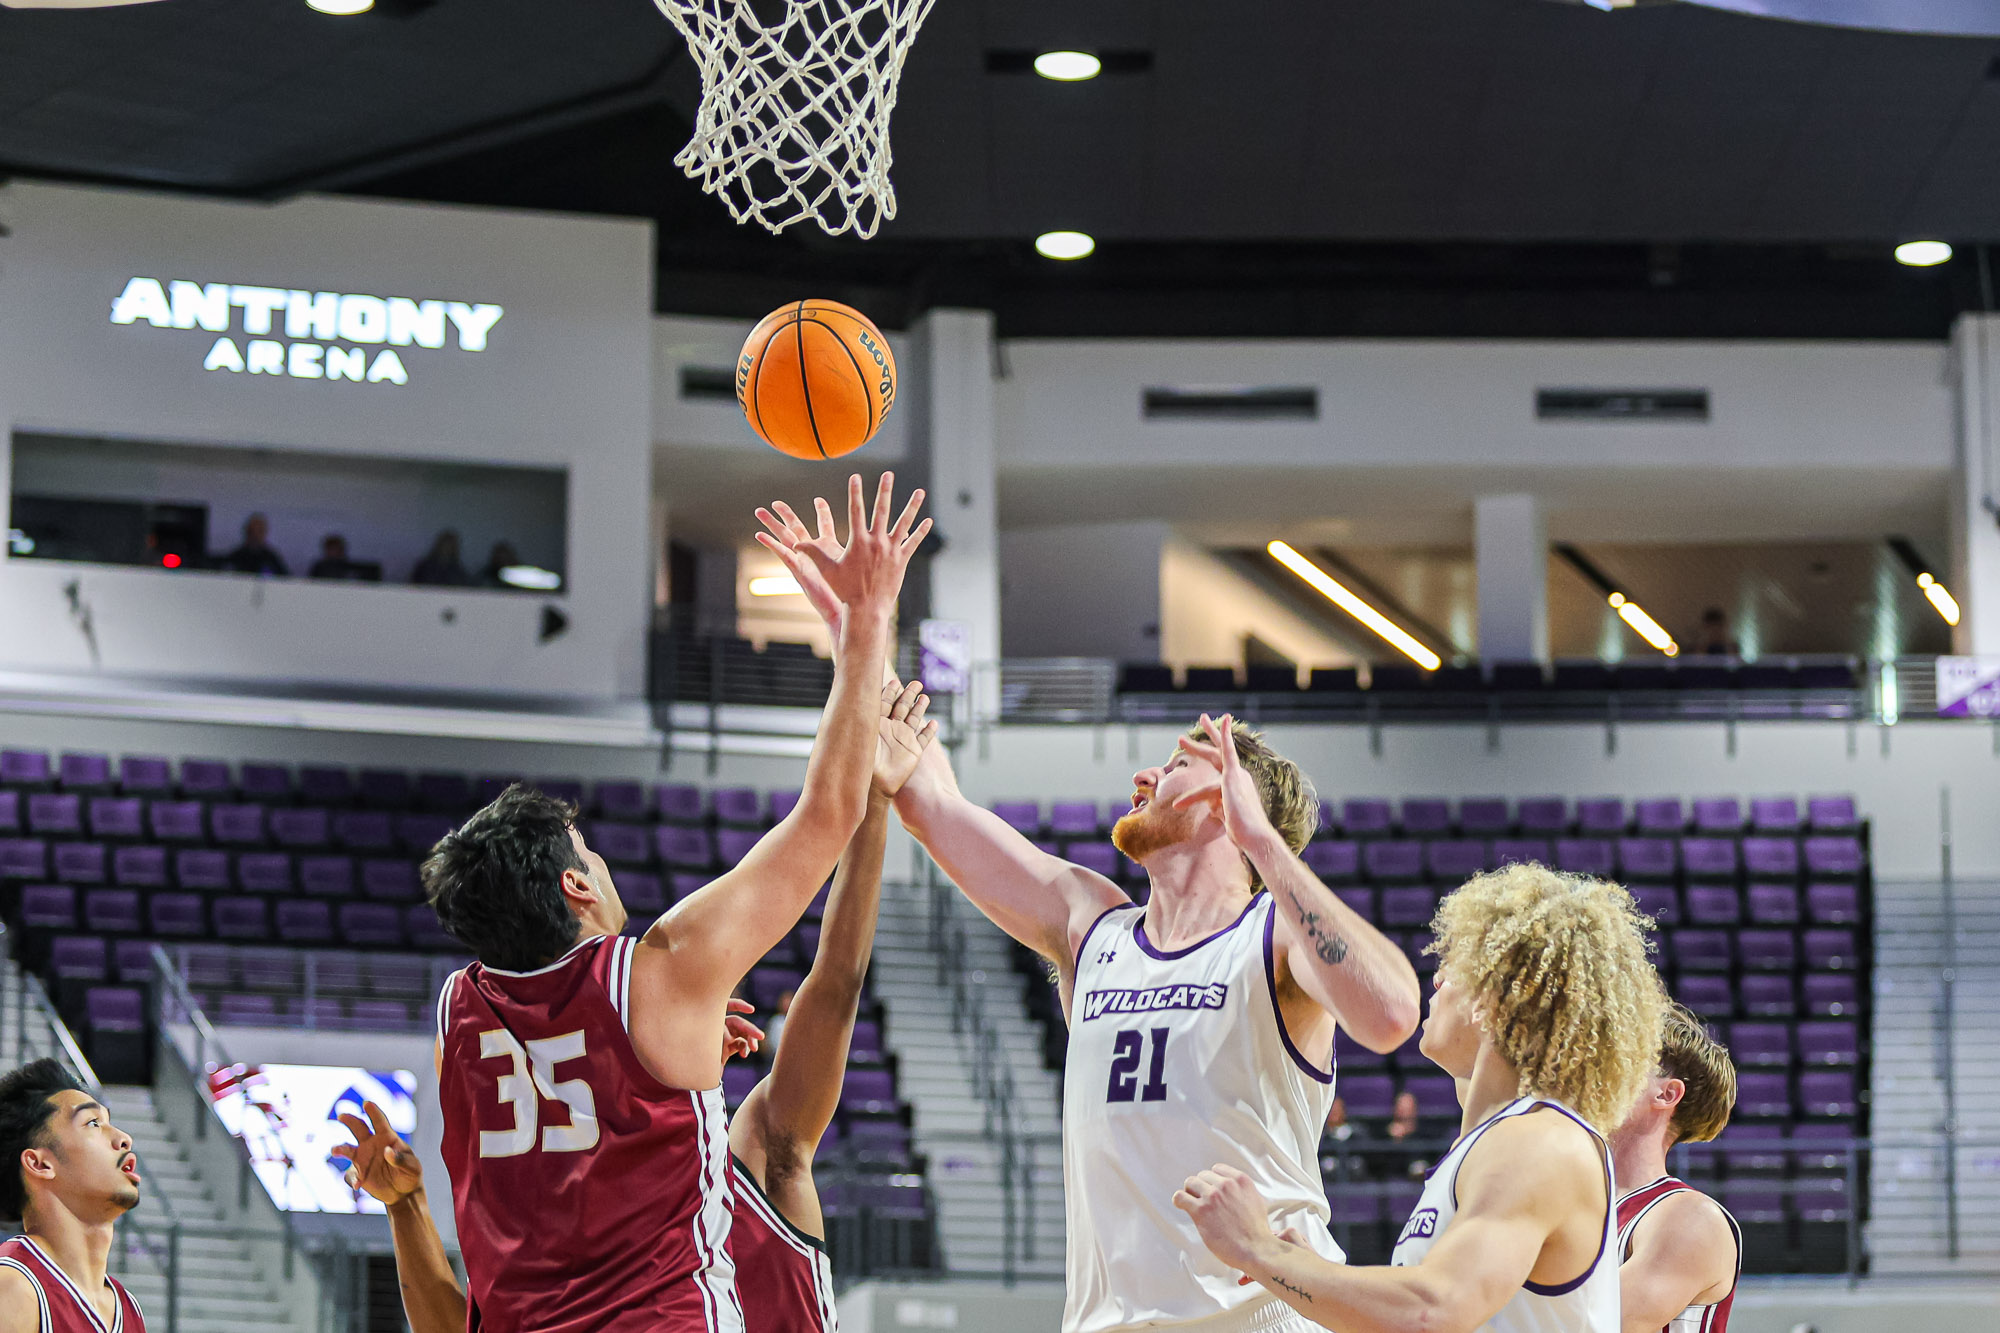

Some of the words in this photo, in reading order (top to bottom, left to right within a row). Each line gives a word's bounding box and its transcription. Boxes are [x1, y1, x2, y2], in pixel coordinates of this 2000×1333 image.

[110, 277, 504, 352] ANTHONY
[204, 336, 409, 386] ARENA
[1084, 983, 1228, 1022] WILDCATS
[479, 1029, 600, 1159] 35
[1107, 1027, 1170, 1103] 21
